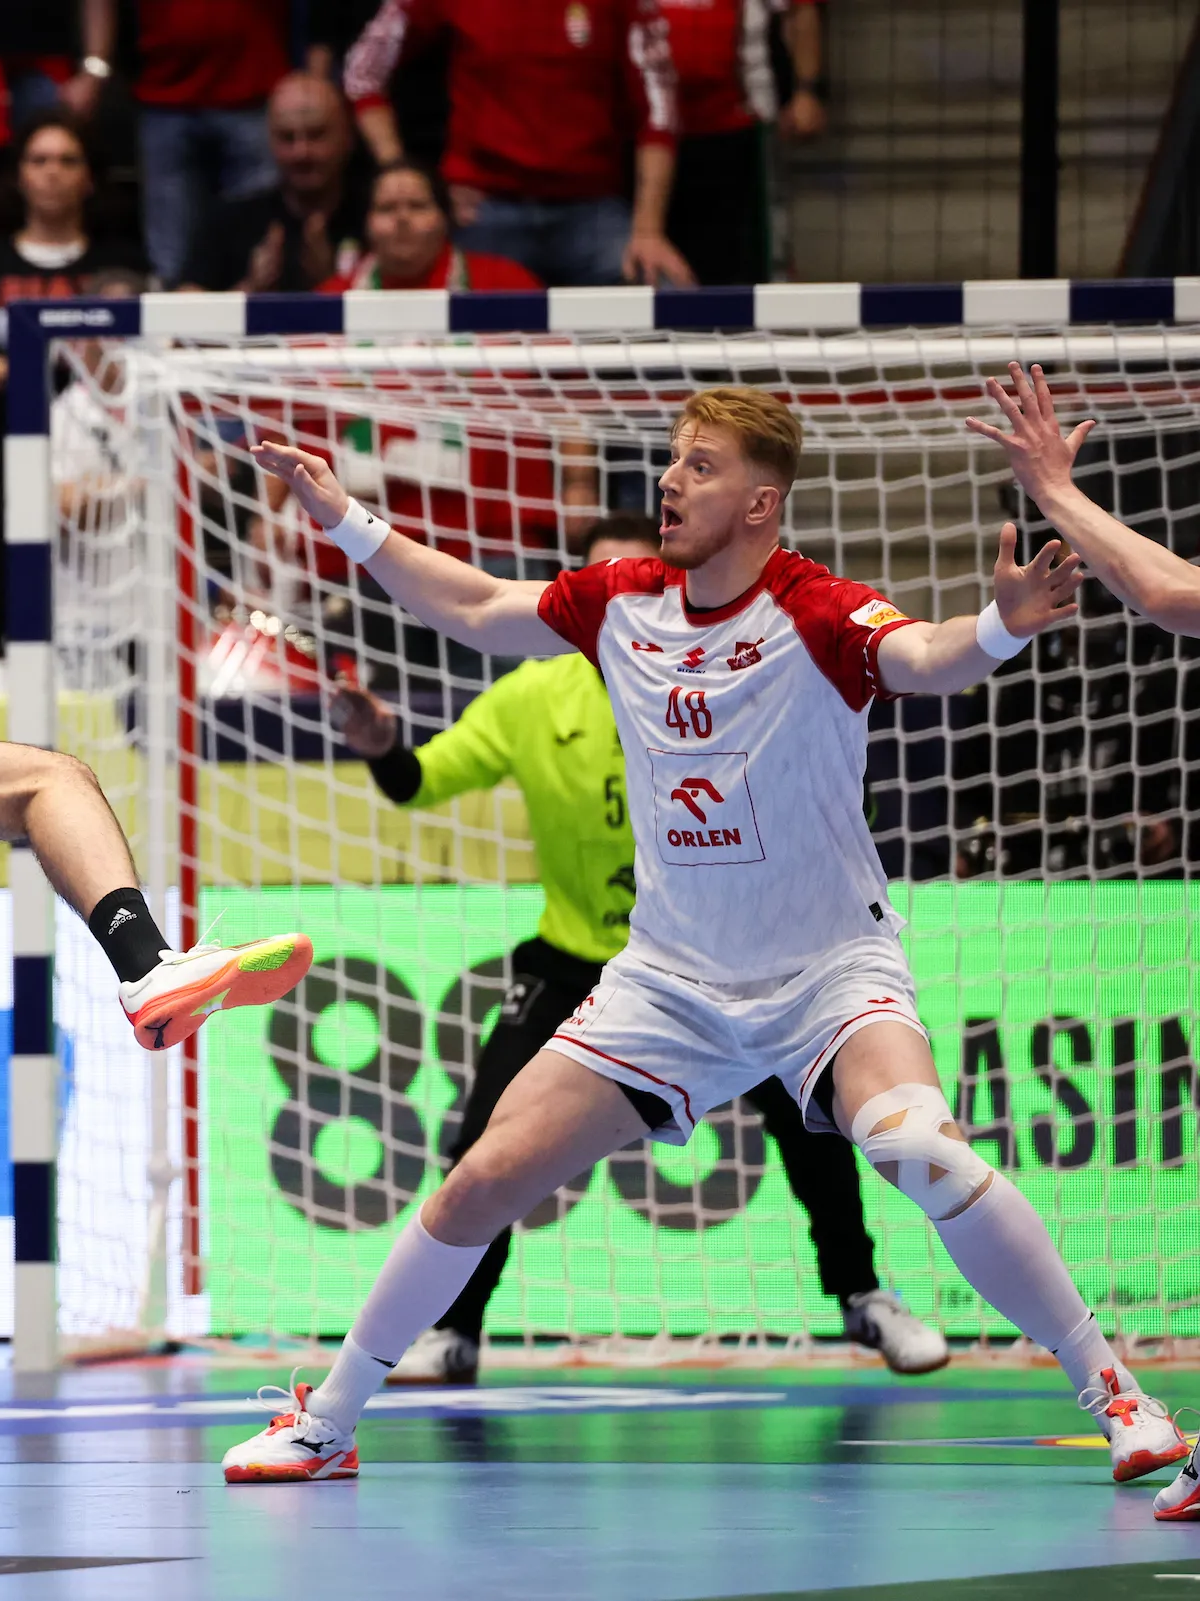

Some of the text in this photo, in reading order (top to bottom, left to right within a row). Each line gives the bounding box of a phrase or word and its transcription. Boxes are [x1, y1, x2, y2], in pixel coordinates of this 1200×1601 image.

[666, 686, 712, 738] 48
[667, 828, 741, 847] ORLEN
[107, 913, 138, 935] adidas
